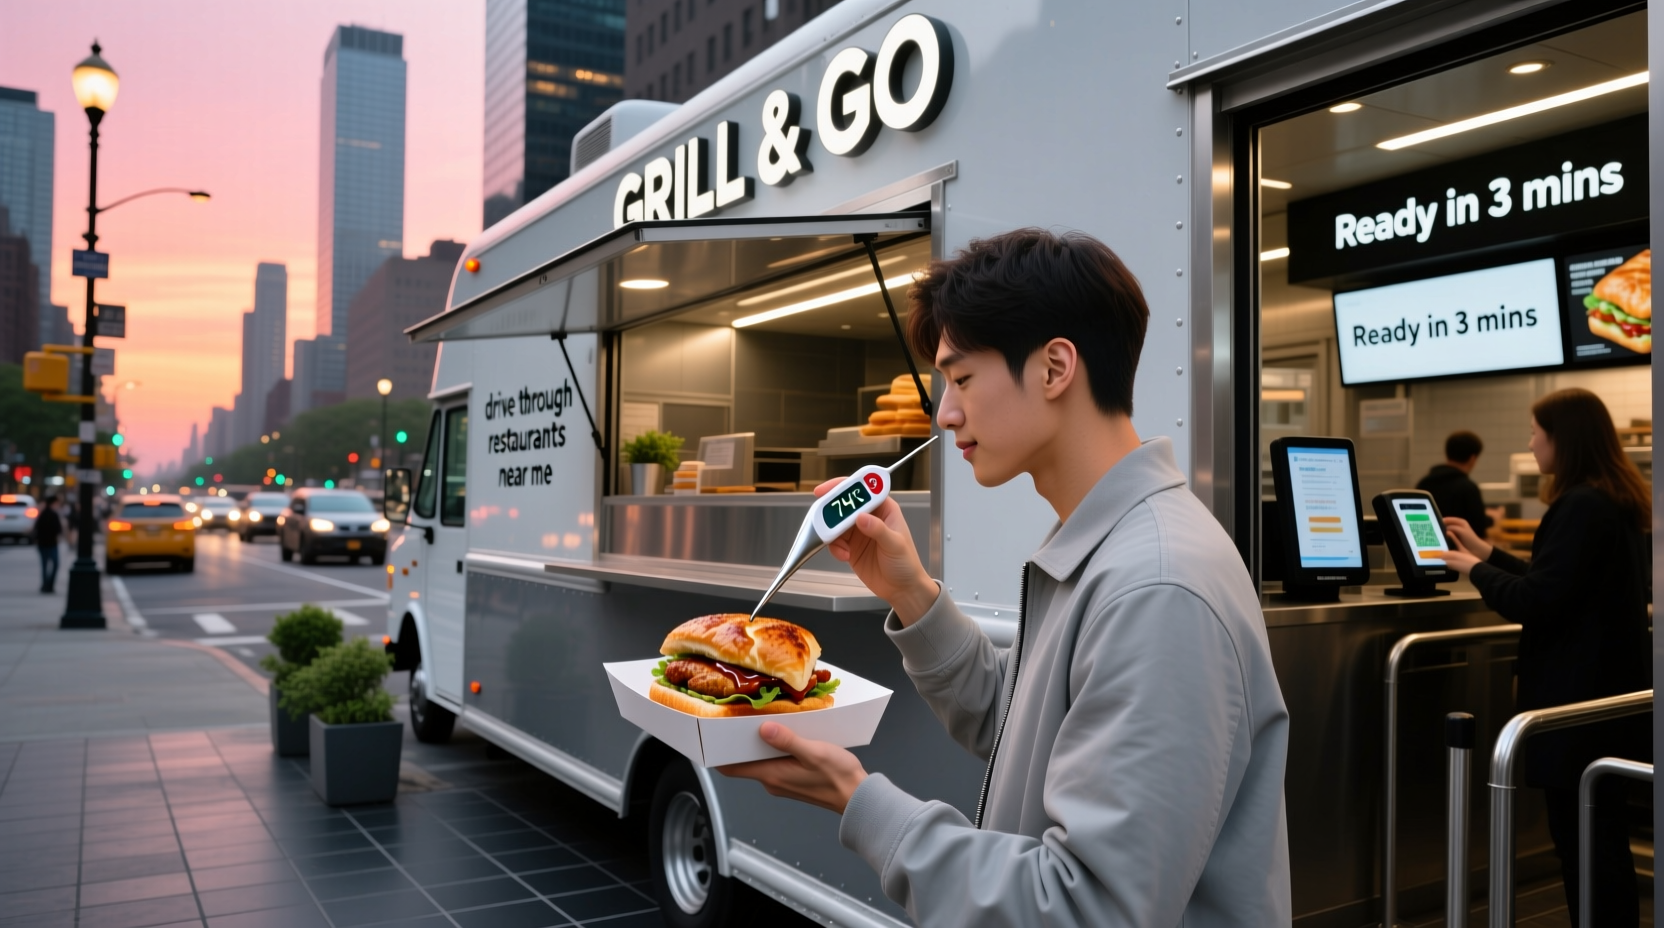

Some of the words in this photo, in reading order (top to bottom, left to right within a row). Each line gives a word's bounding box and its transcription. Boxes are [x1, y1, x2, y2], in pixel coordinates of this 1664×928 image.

[614, 120, 748, 229] GRILL
[757, 89, 803, 186] &
[817, 13, 944, 156] GO
[1335, 197, 1439, 250] Ready
[1446, 187, 1479, 227] in
[1488, 177, 1513, 217] 3
[1522, 161, 1625, 212] mins
[1353, 318, 1421, 347] Ready
[1428, 314, 1449, 338] in
[1455, 311, 1470, 335] 3
[1477, 305, 1538, 333] mins
[485, 391, 516, 421] drive
[519, 377, 573, 418] through
[488, 421, 566, 455] restaurants
[499, 466, 529, 488] near
[531, 463, 553, 486] me
